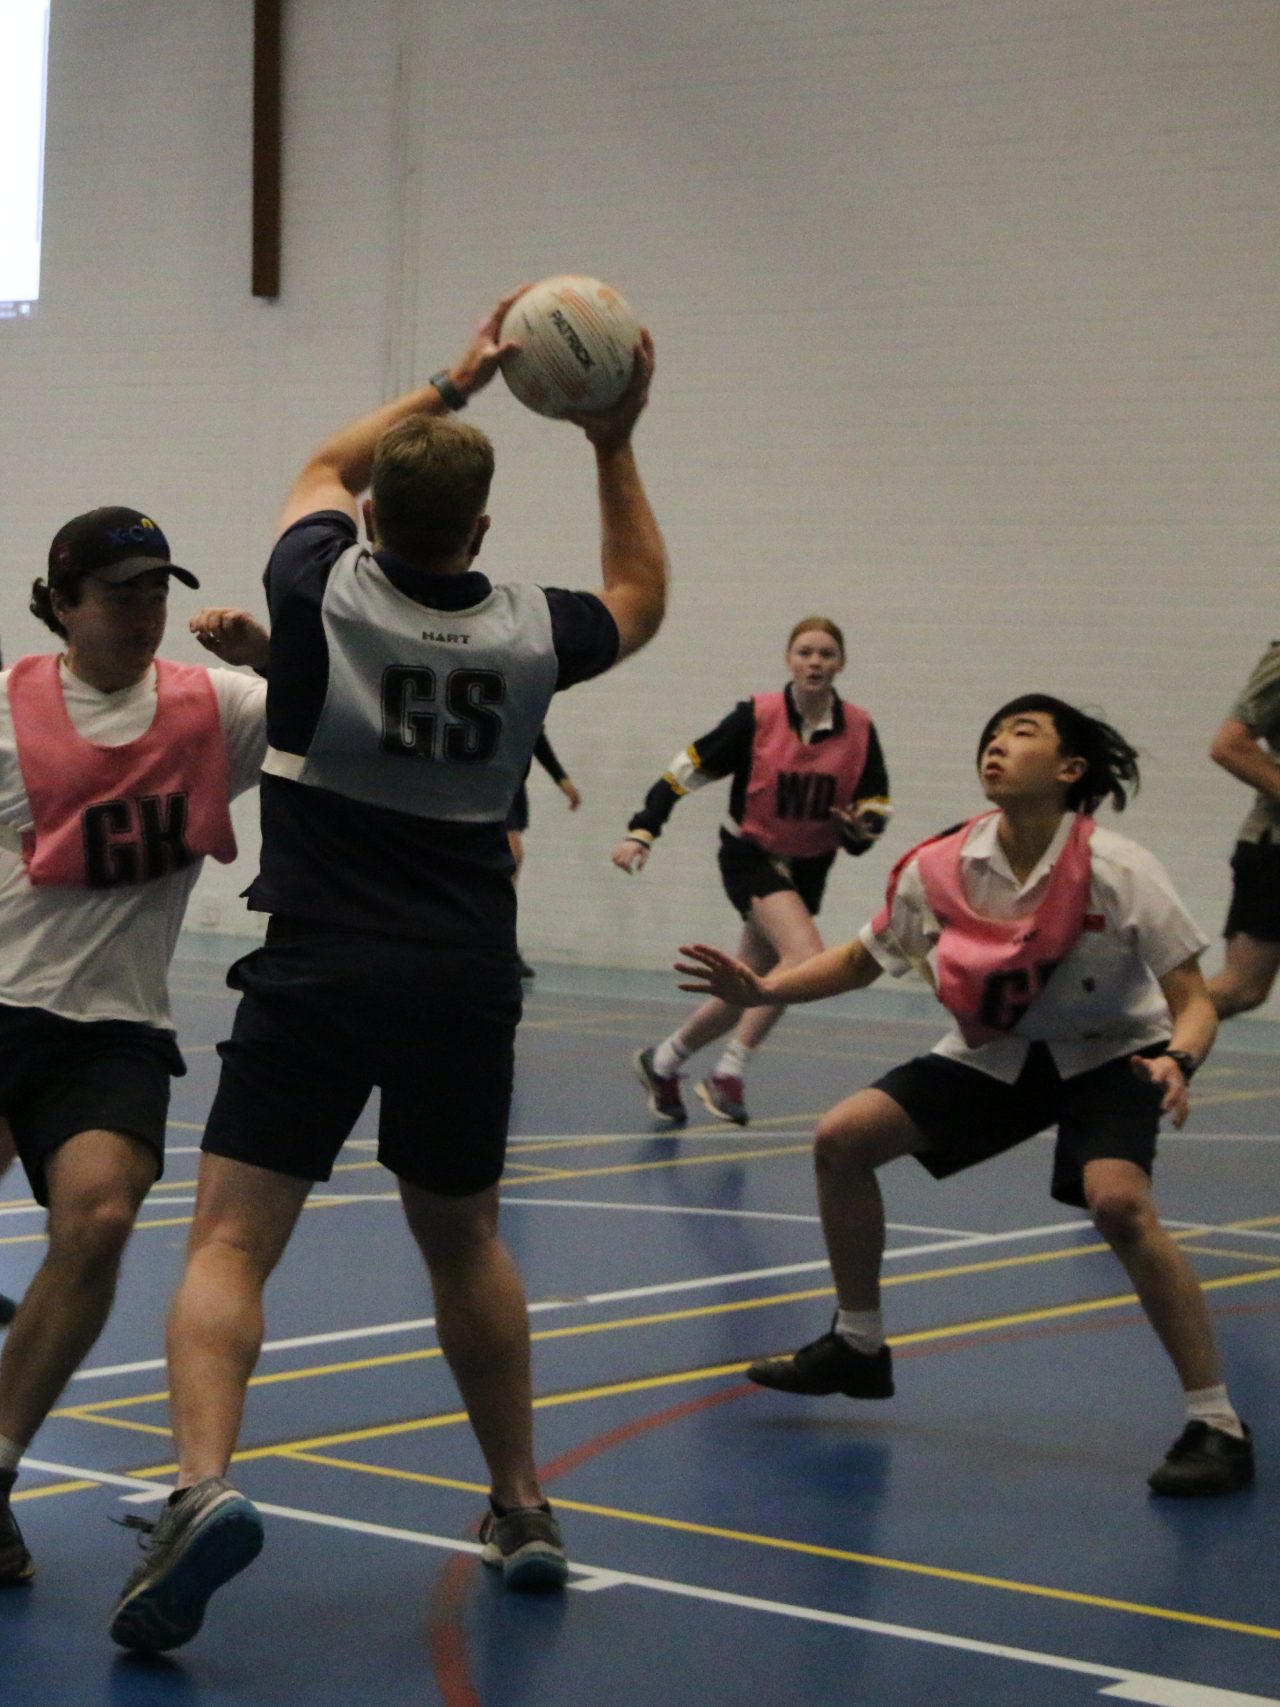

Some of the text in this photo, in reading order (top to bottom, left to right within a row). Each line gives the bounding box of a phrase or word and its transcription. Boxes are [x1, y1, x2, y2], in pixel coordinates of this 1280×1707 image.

[422, 631, 471, 644] HART
[380, 663, 507, 765] GS
[776, 771, 838, 821] WD
[82, 791, 195, 890] GK
